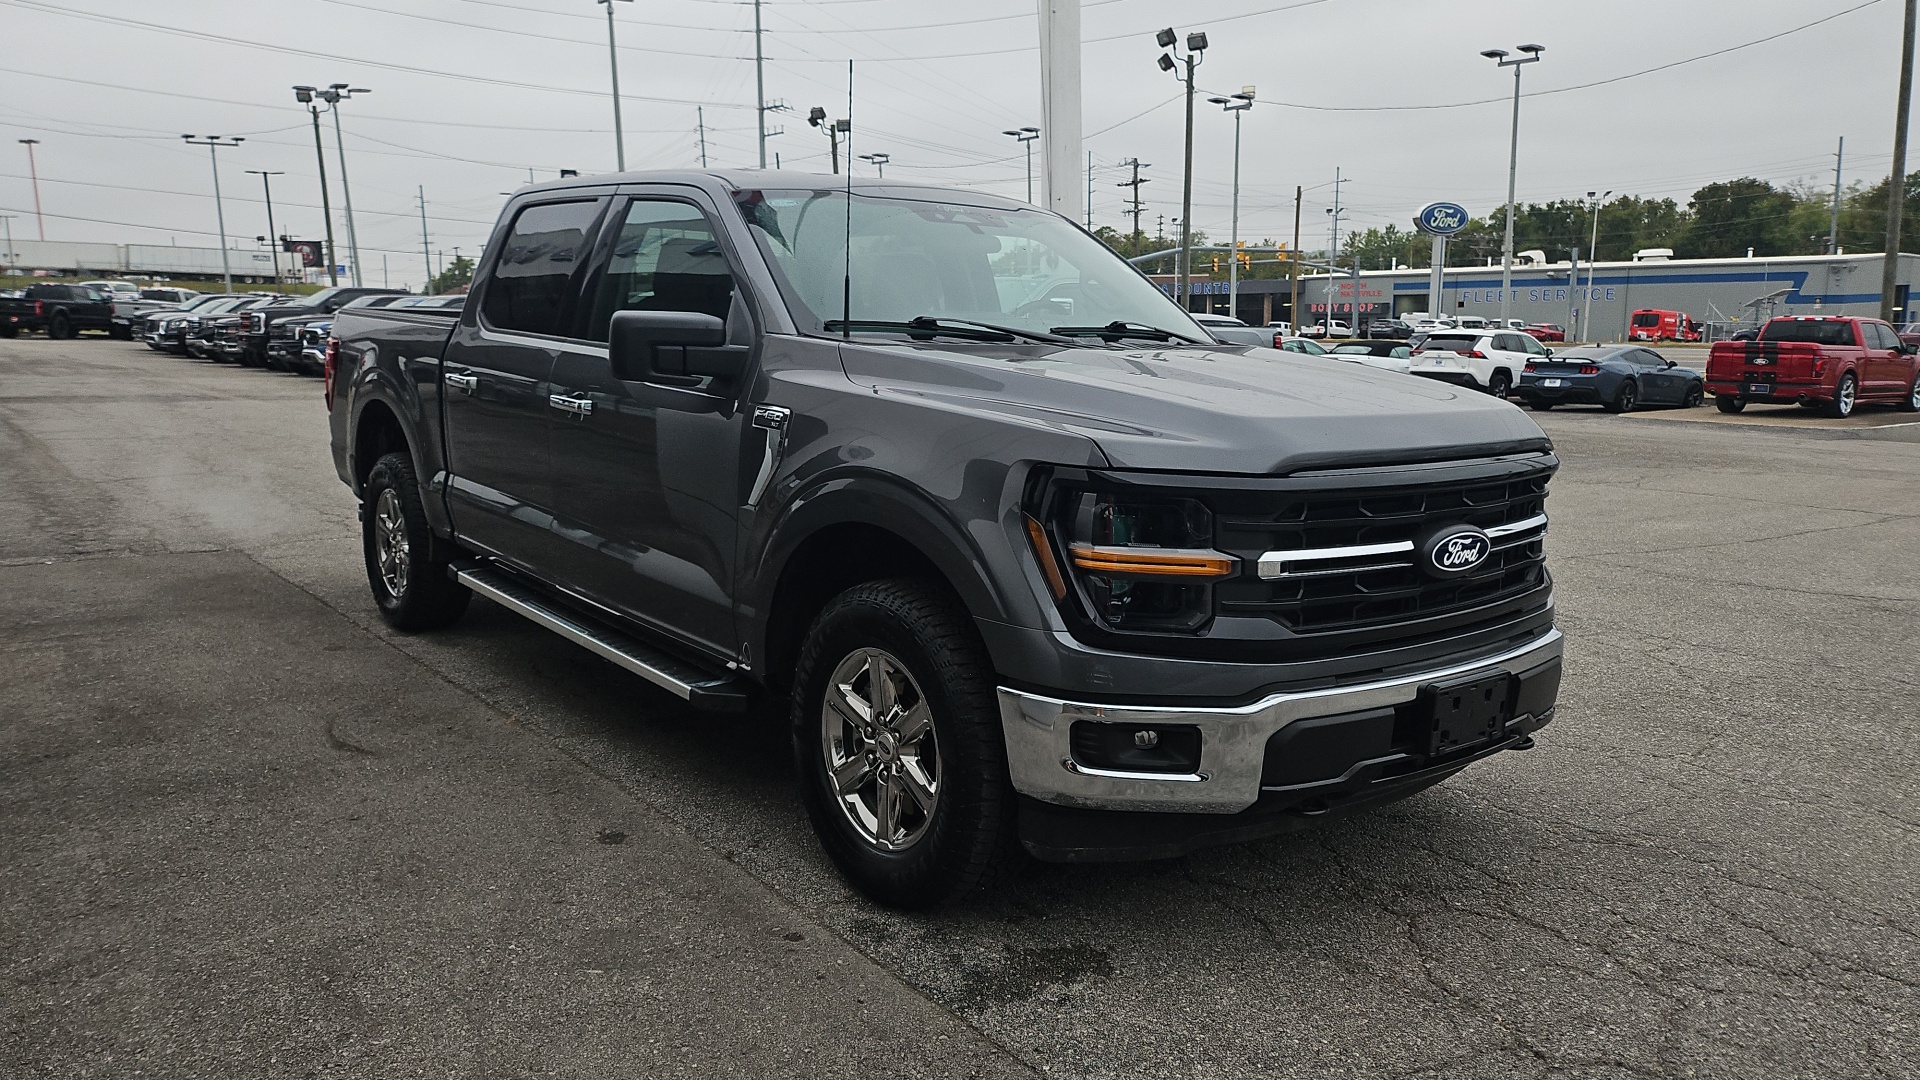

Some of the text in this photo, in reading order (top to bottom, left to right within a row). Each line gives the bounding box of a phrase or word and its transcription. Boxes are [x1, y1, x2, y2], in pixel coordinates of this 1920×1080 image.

[1430, 207, 1461, 227] Ford
[1340, 290, 1382, 298] NASVILLE
[1529, 287, 1616, 302] SERICE
[1443, 537, 1481, 566] Ford
